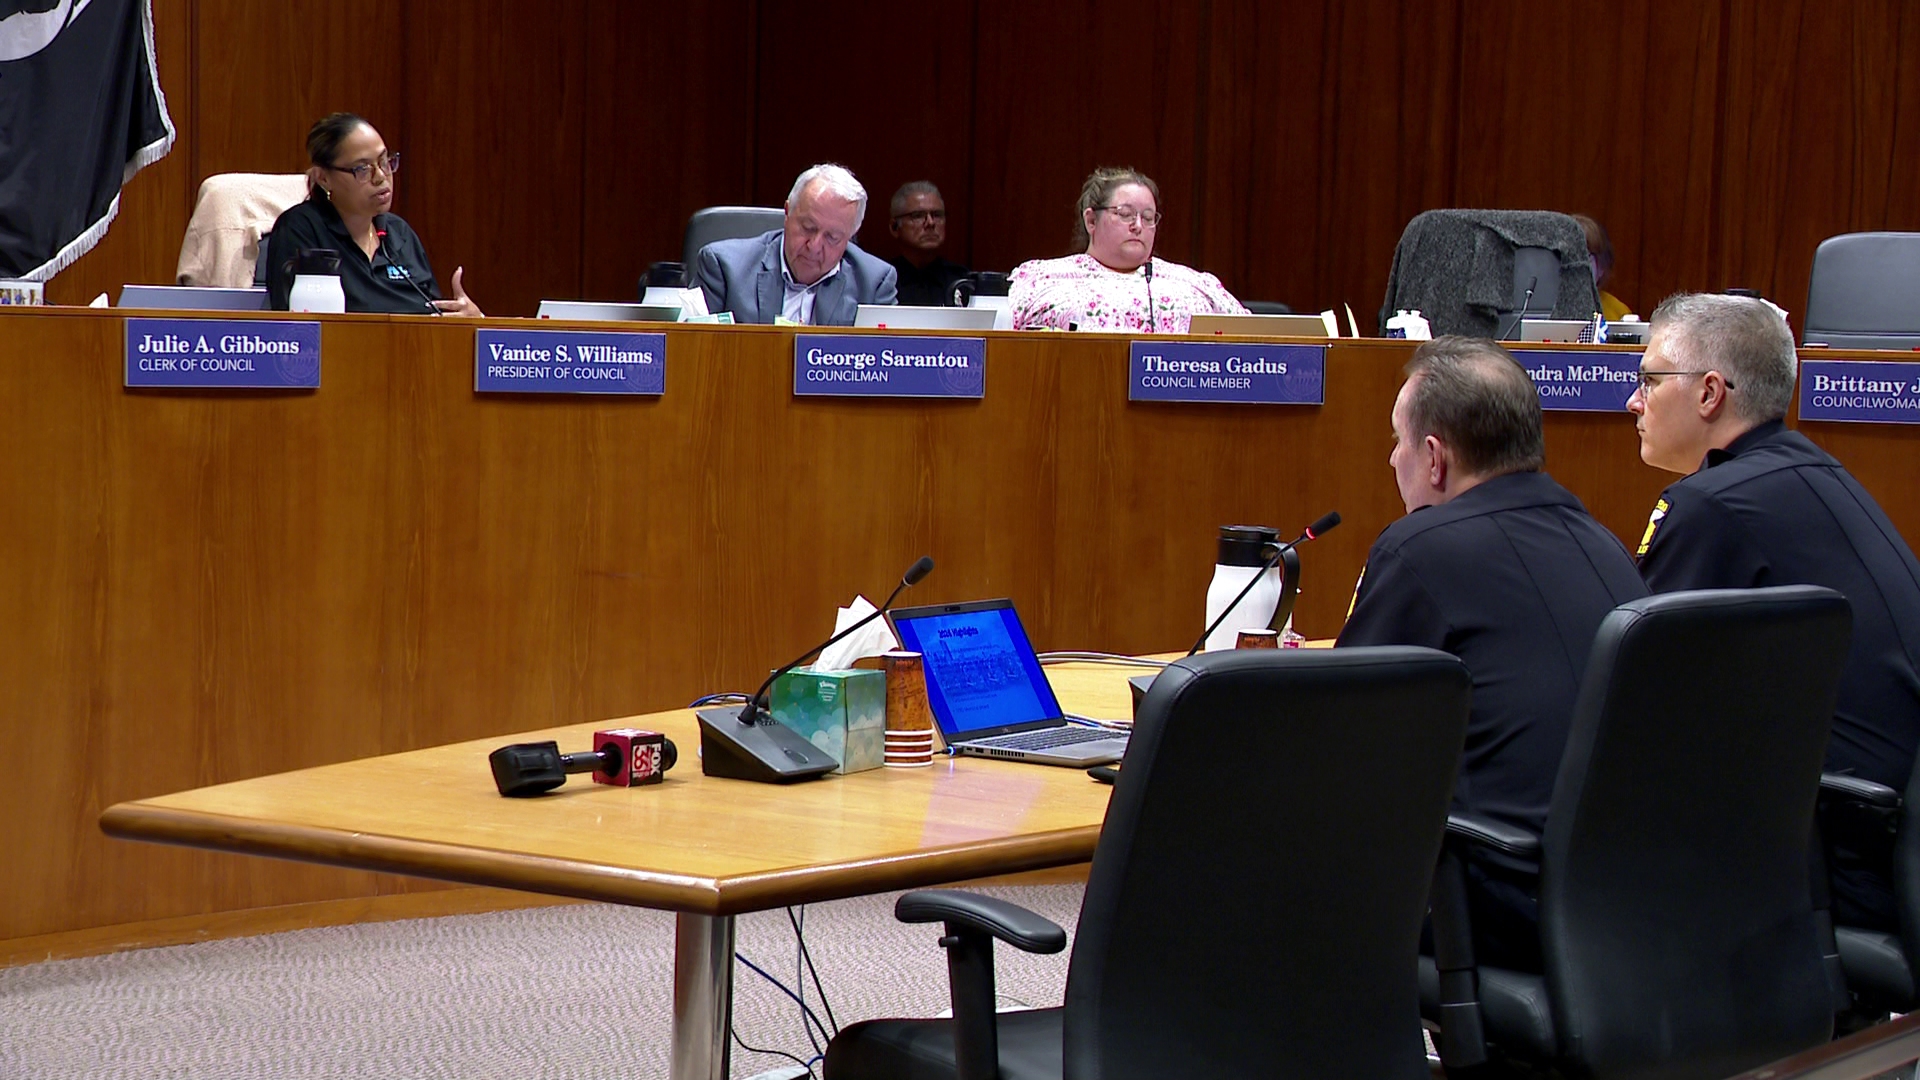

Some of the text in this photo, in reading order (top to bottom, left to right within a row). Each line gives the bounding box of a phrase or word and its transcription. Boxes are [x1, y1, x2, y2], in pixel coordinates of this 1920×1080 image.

[138, 334, 300, 355] Julie A. Gibbons
[488, 343, 653, 365] Vanice S. Williams
[139, 358, 256, 371] CLERK OF COUNCIL
[807, 348, 969, 370] George Sarantou
[1142, 355, 1288, 375] Theresa Gadus
[488, 366, 626, 380] PRESIDENT OF COUNCIL
[806, 369, 888, 382] COUNCILMAN
[1141, 376, 1251, 389] COUNCIL MEMBER
[1813, 375, 1907, 397] Brittany
[1812, 395, 1920, 409] COUNCILWOMA
[634, 746, 649, 769] 36
[650, 743, 661, 775] FOX
